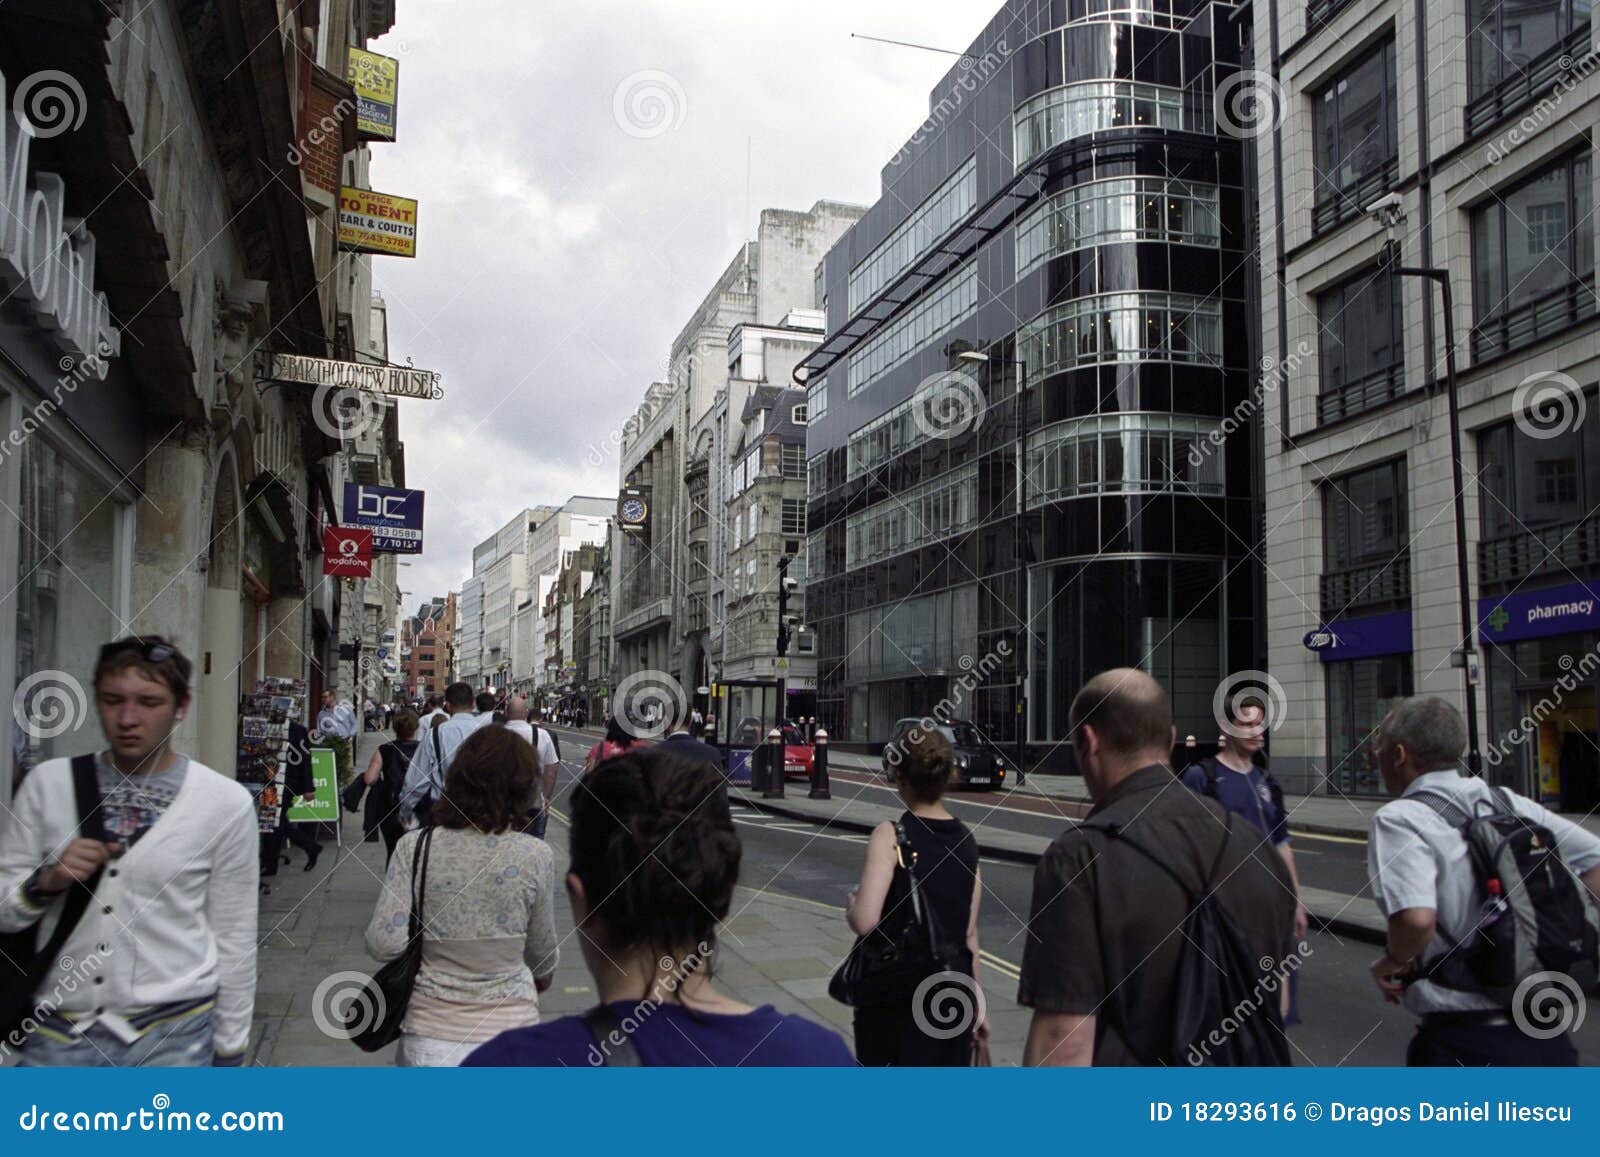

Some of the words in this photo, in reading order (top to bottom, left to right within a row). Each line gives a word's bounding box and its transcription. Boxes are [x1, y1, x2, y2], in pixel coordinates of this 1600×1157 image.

[340, 197, 361, 212] TO
[366, 203, 413, 222] RENT
[359, 192, 392, 205] OFFICE
[340, 213, 365, 227] EARL
[367, 219, 375, 229] &
[377, 221, 414, 237] COUTTS
[288, 356, 385, 391] BARTHOLOMEW
[388, 368, 429, 396] HOUSE
[357, 485, 406, 519] bc
[391, 540, 401, 548] TO
[392, 529, 417, 539] 0588
[327, 557, 368, 568] vodafone
[1527, 600, 1594, 623] pharmacy
